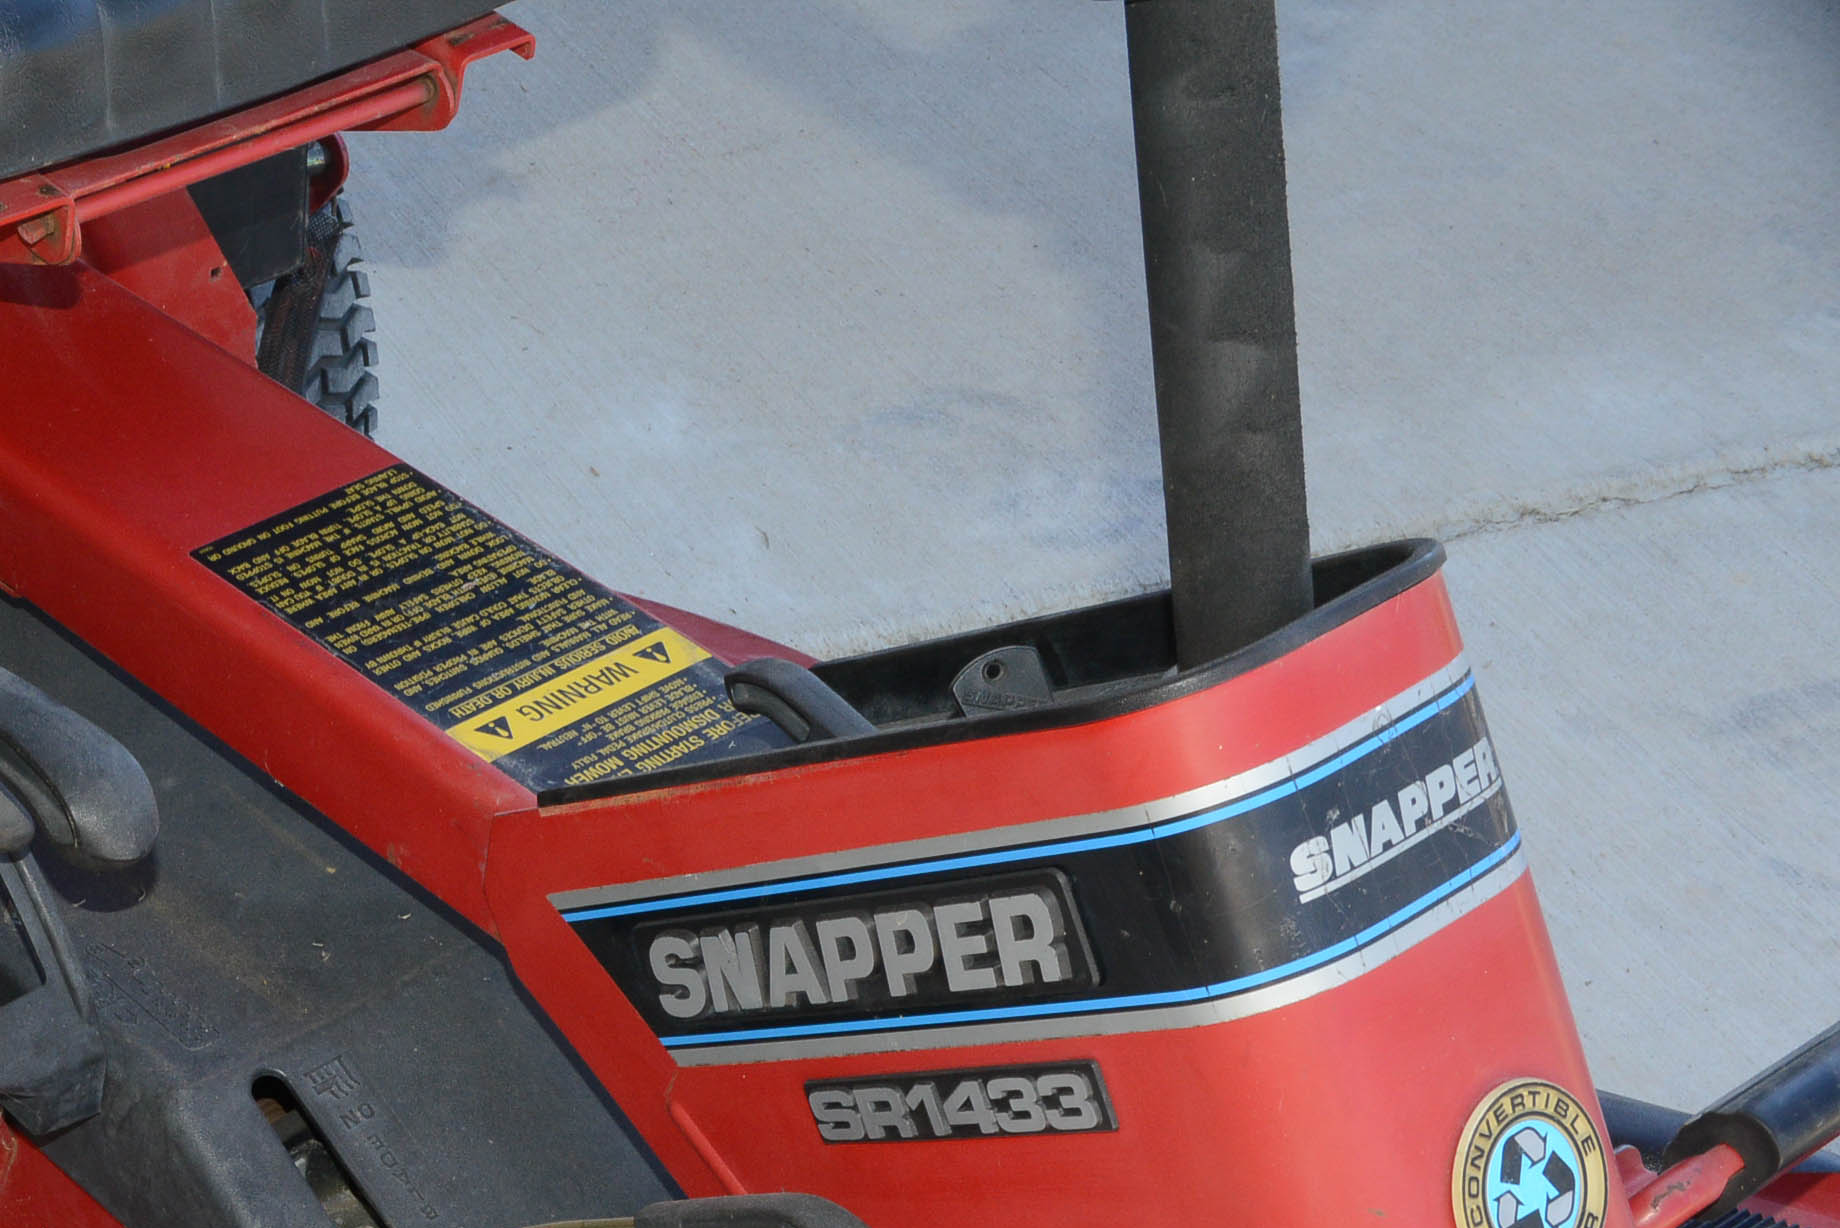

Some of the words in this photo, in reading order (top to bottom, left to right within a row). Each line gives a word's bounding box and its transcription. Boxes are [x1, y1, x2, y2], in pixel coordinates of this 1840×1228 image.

[603, 625, 644, 646] AVOID
[552, 641, 609, 670] SERIOUS
[508, 664, 558, 690] INJURY
[488, 684, 515, 699] OR
[513, 659, 639, 722] WARNING
[662, 684, 696, 701] BLADE
[666, 690, 705, 710] ENGAGE
[448, 694, 494, 718] DEATH
[605, 701, 638, 718] LEVER
[635, 697, 668, 714] LEVER
[682, 696, 715, 714] PRESS
[592, 715, 610, 725] TO
[611, 710, 641, 726] MUST
[631, 706, 672, 727] PARKING
[598, 722, 617, 733] BE
[603, 723, 637, 741] BRAKE
[616, 707, 725, 761] DISMOUNTING
[594, 739, 627, 756] PEDAL
[630, 734, 708, 773] STARTING
[567, 752, 600, 769] FULLY
[1290, 737, 1501, 893] SNAPPER
[649, 892, 1063, 1019] SNAPPER
[807, 1073, 1100, 1142] SR1433
[1468, 1090, 1596, 1228] CONVERTIBLE
